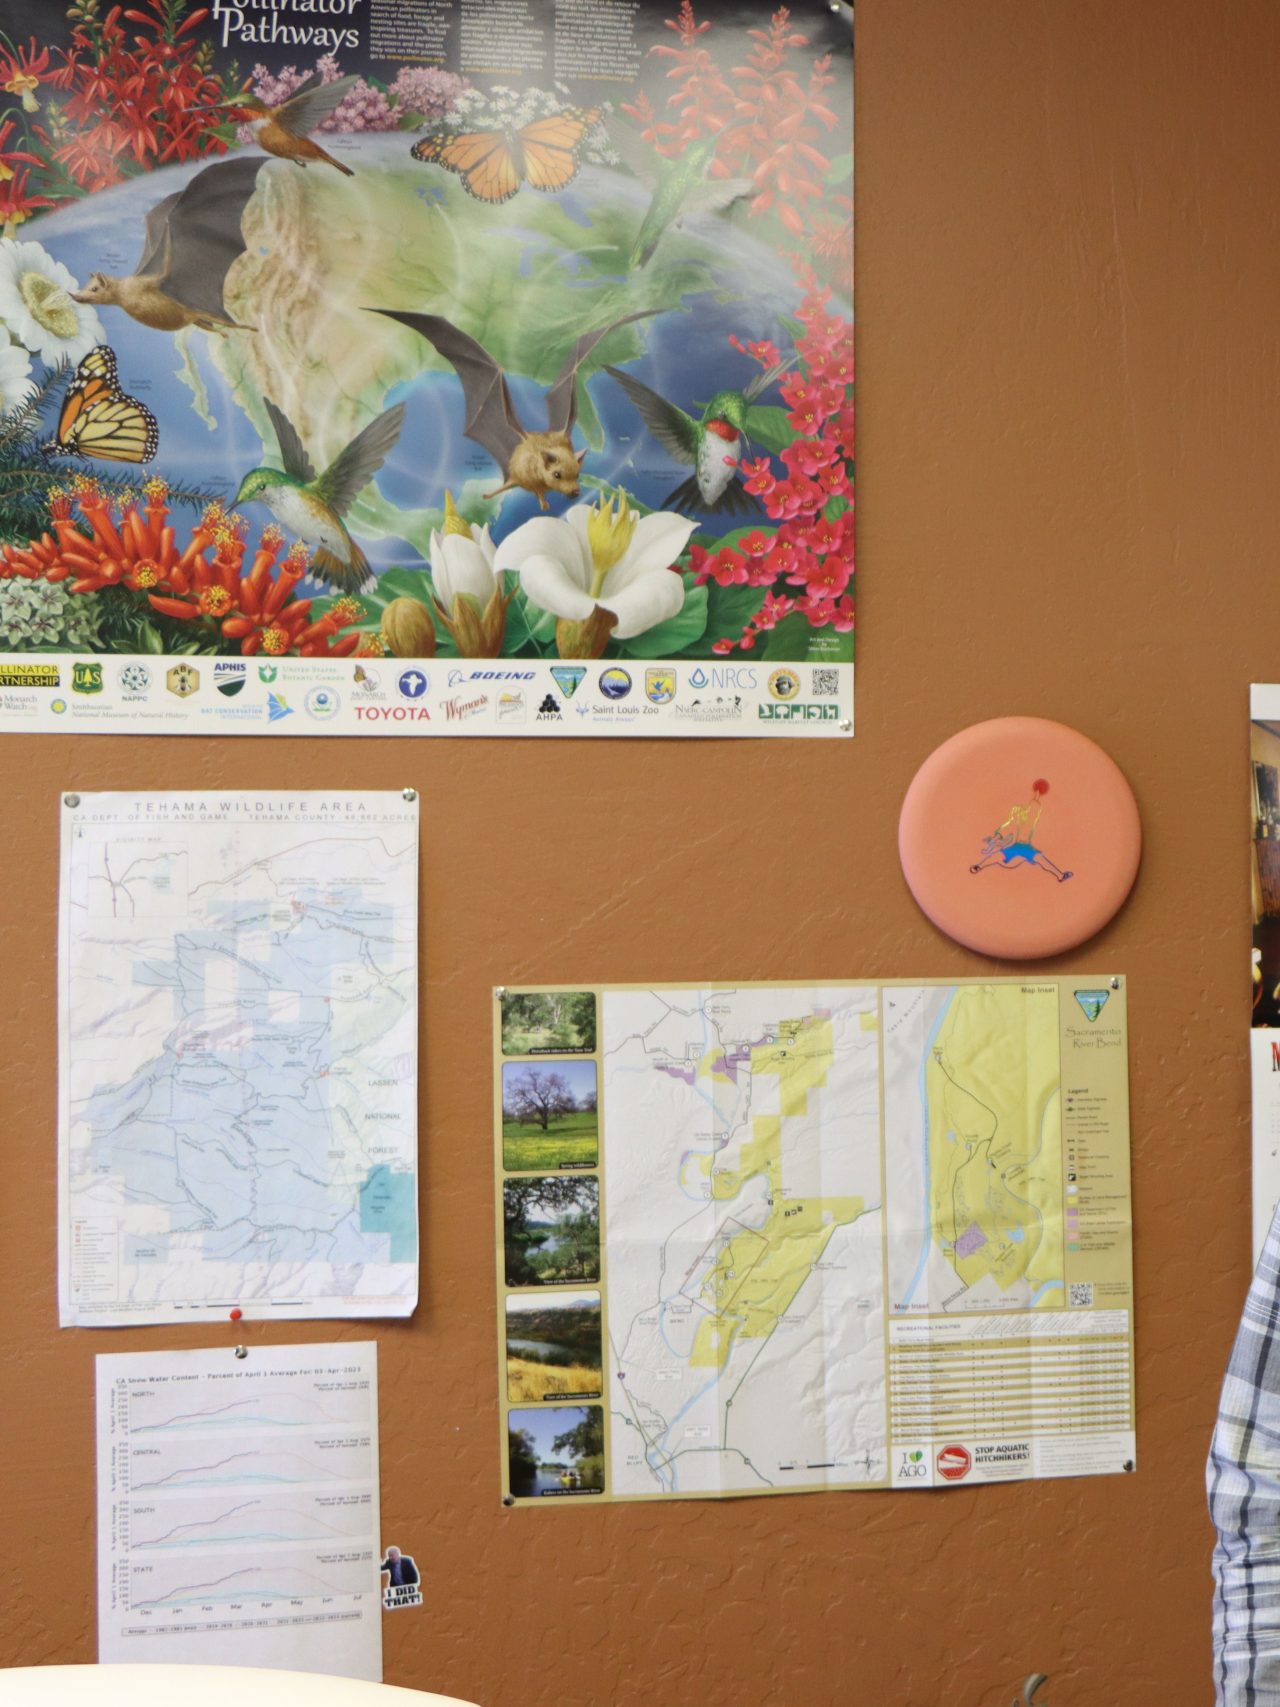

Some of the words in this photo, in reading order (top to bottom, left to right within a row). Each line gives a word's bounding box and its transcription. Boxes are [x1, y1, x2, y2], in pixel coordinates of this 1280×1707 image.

[213, 8, 359, 57] Pathways
[0, 665, 59, 674] LLINATOR
[214, 663, 246, 672] APHIS
[470, 672, 536, 680] BOEING
[712, 668, 758, 689] NRCS
[354, 706, 431, 720] TOYOTA
[592, 704, 614, 714] Saint
[617, 704, 640, 714] Louis
[642, 705, 660, 714] Zoo
[134, 802, 208, 812] TEHAMA
[220, 802, 308, 812] WILDLIFE
[320, 802, 367, 812] AREA
[1021, 986, 1036, 994] Map
[894, 1303, 910, 1311] Map
[208, 1372, 234, 1380] Percent
[244, 1371, 261, 1379] April
[975, 1446, 994, 1454] STOP
[996, 1444, 1030, 1453] AQUATIC
[902, 1452, 908, 1464] I
[975, 1453, 1030, 1464] HITCHHIKERS!
[898, 1464, 927, 1478] AGO
[133, 1506, 156, 1514] SOUTH
[387, 1588, 392, 1598] I
[396, 1586, 416, 1596] DID
[384, 1594, 420, 1607] THAT!
